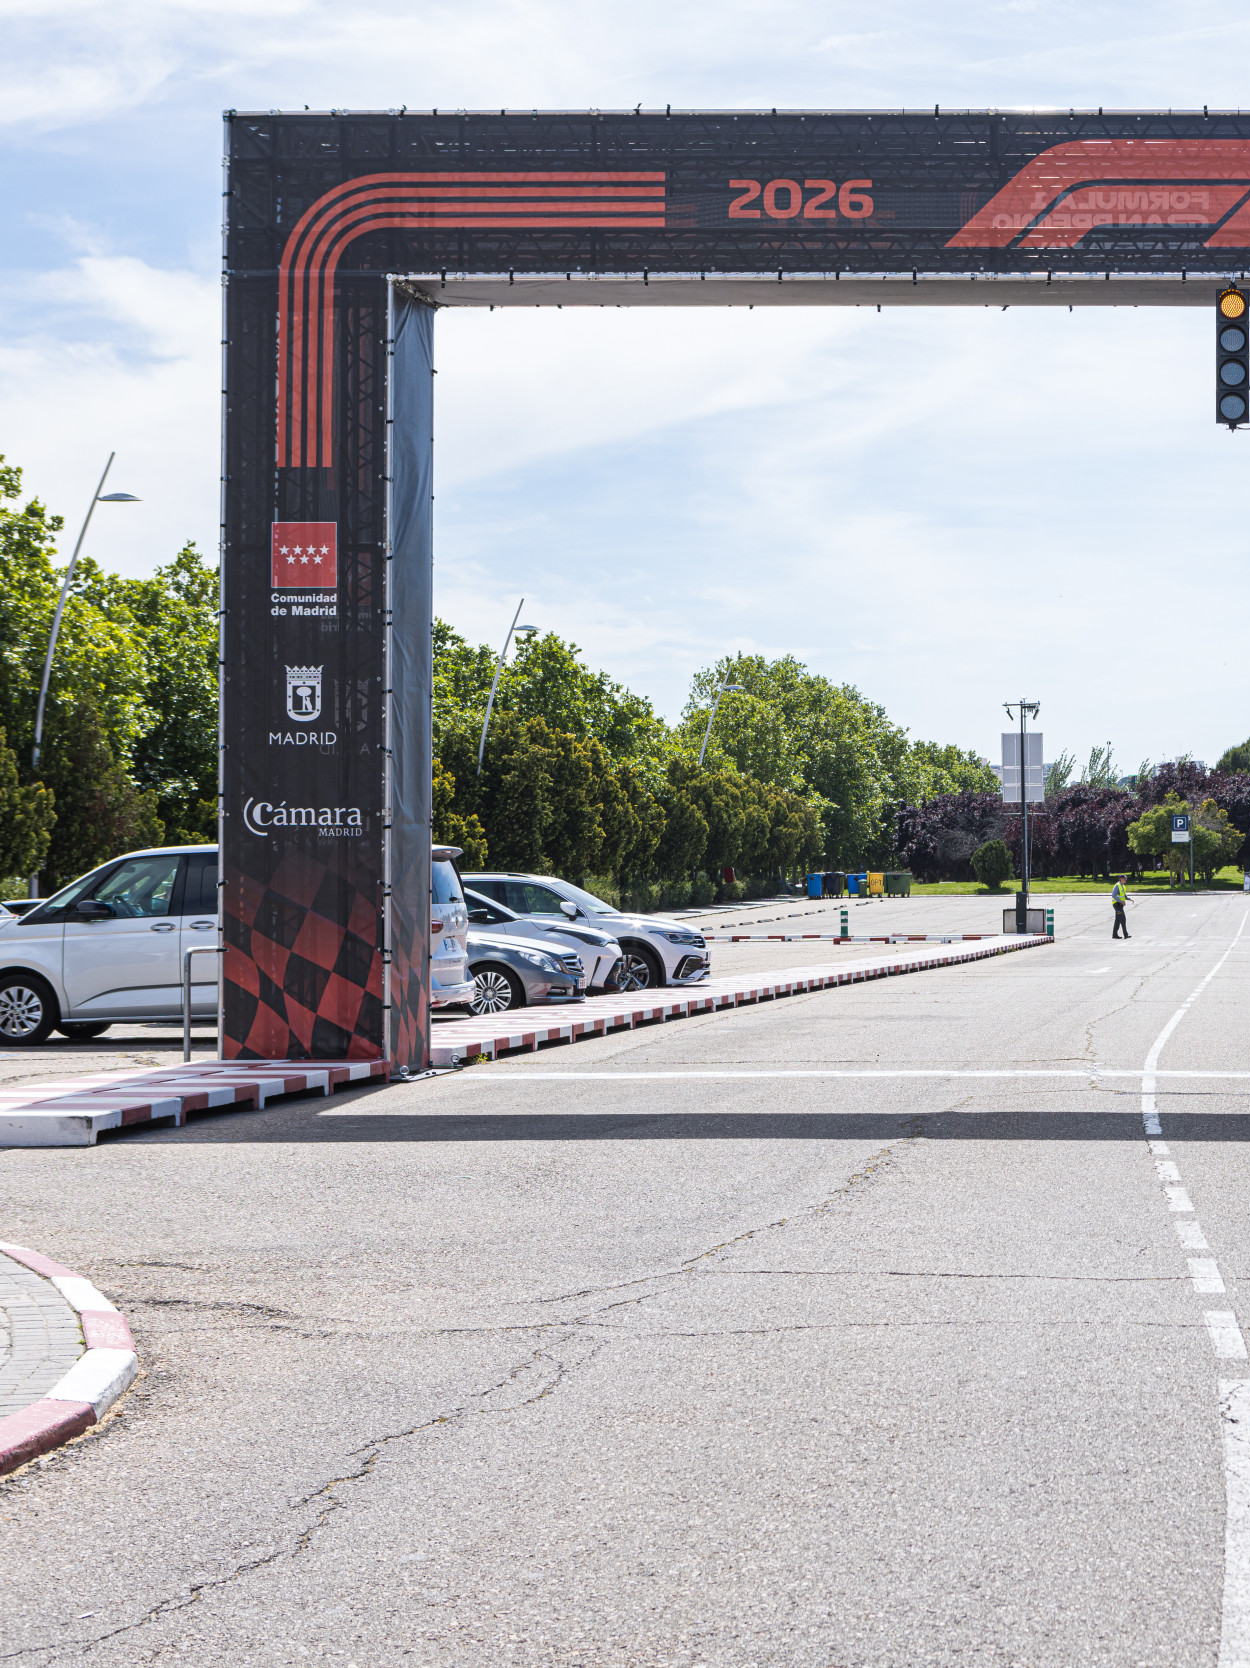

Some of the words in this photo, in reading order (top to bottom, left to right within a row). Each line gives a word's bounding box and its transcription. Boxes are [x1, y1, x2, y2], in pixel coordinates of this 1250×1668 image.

[728, 179, 874, 219] 2026
[271, 593, 338, 603] Comunidad
[271, 605, 288, 616] de
[291, 605, 338, 616] Madrid
[269, 732, 338, 745] MADRID
[252, 800, 363, 826] Cámara
[318, 827, 363, 837] MADRID
